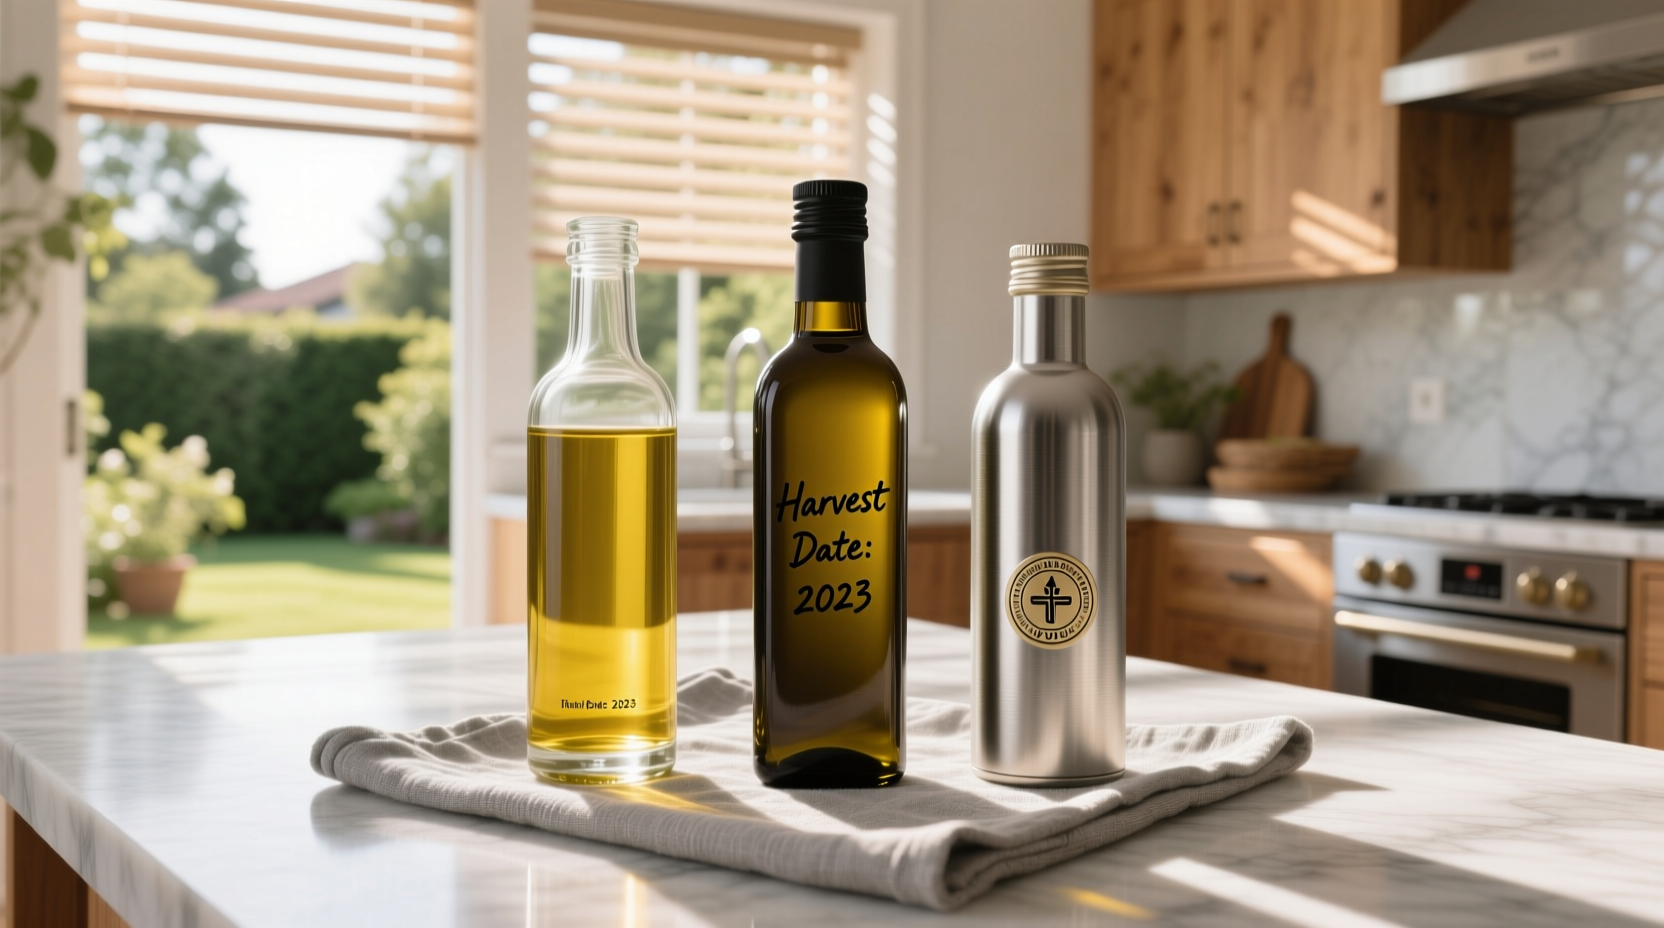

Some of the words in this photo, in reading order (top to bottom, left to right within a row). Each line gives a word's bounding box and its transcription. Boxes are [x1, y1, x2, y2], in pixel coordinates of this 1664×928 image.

[776, 480, 890, 522] Harvest
[789, 530, 872, 569] Date:
[793, 579, 872, 616] 2023
[611, 699, 636, 709] 2023
